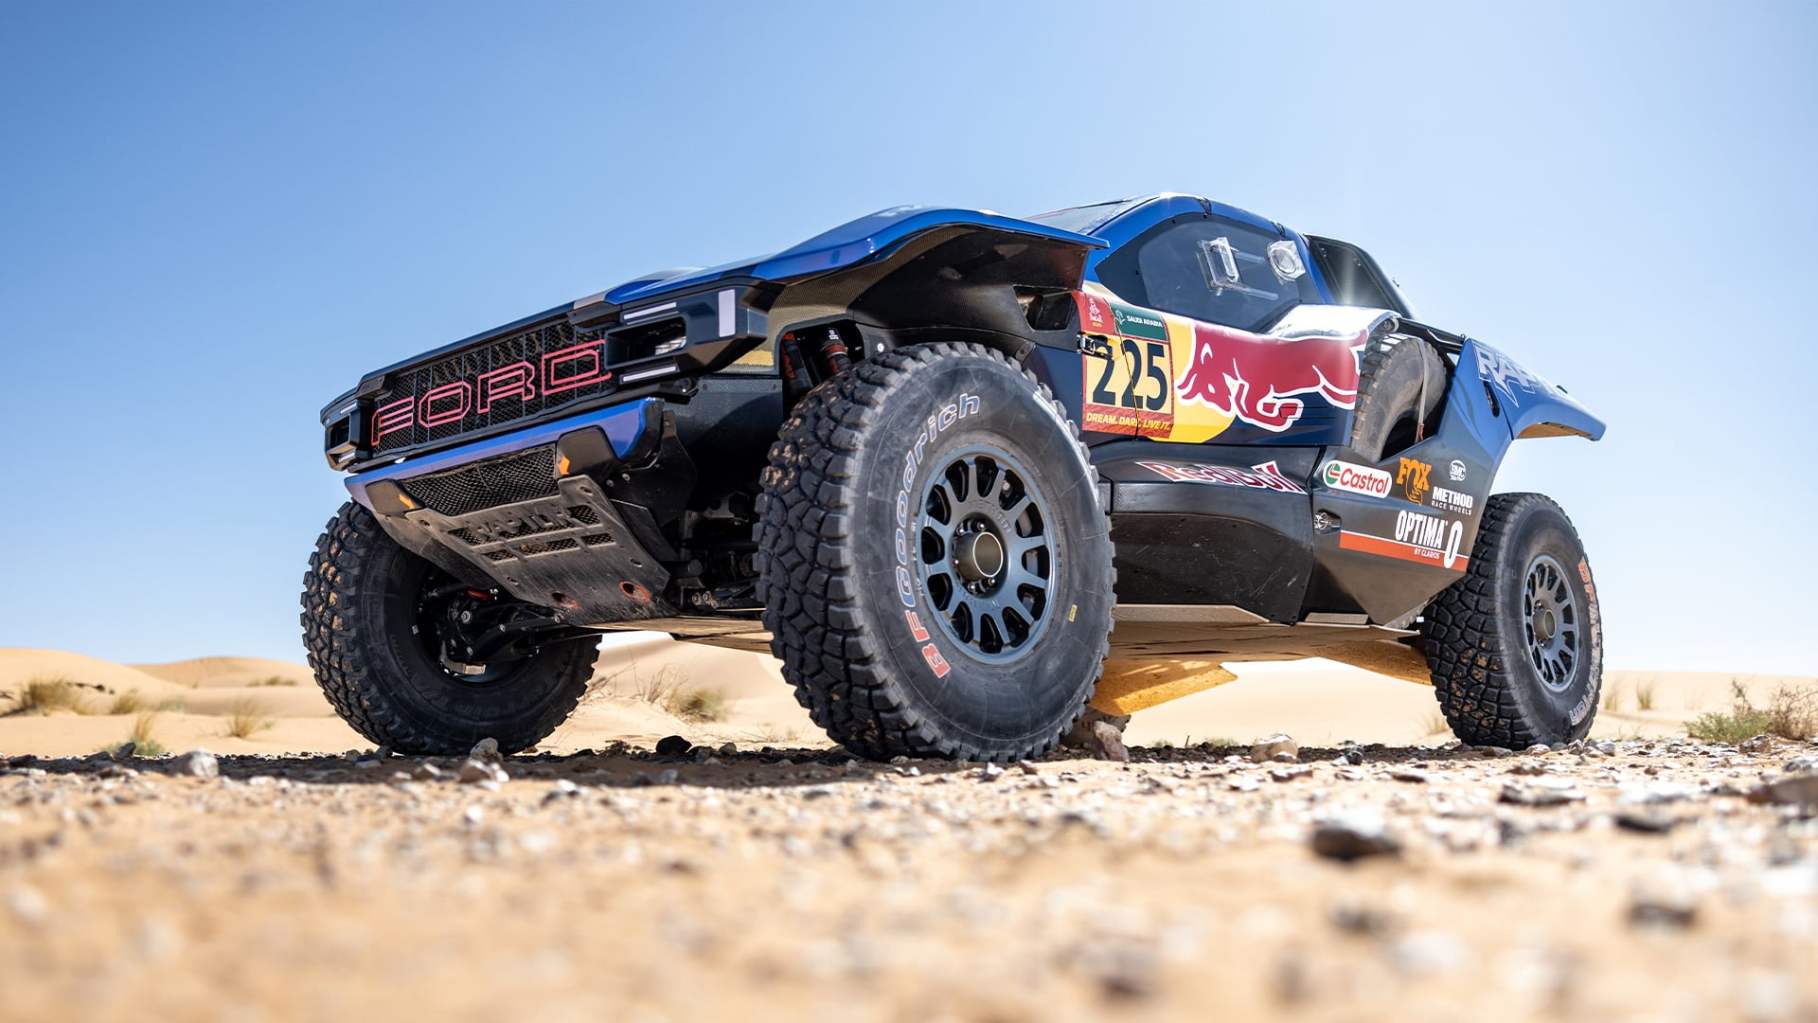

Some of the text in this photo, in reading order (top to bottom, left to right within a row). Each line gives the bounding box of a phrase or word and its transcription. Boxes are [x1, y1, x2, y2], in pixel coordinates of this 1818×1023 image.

[371, 339, 613, 446] FORD
[1093, 337, 1168, 411] 225
[1086, 412, 1118, 425] DREAM.
[1340, 468, 1389, 494] Castrol
[1396, 456, 1433, 497] FOX
[1431, 500, 1447, 510] RACE
[1432, 486, 1474, 508] METHOD
[896, 393, 980, 679] BFGoodrich
[1395, 509, 1446, 549] OPTIMA
